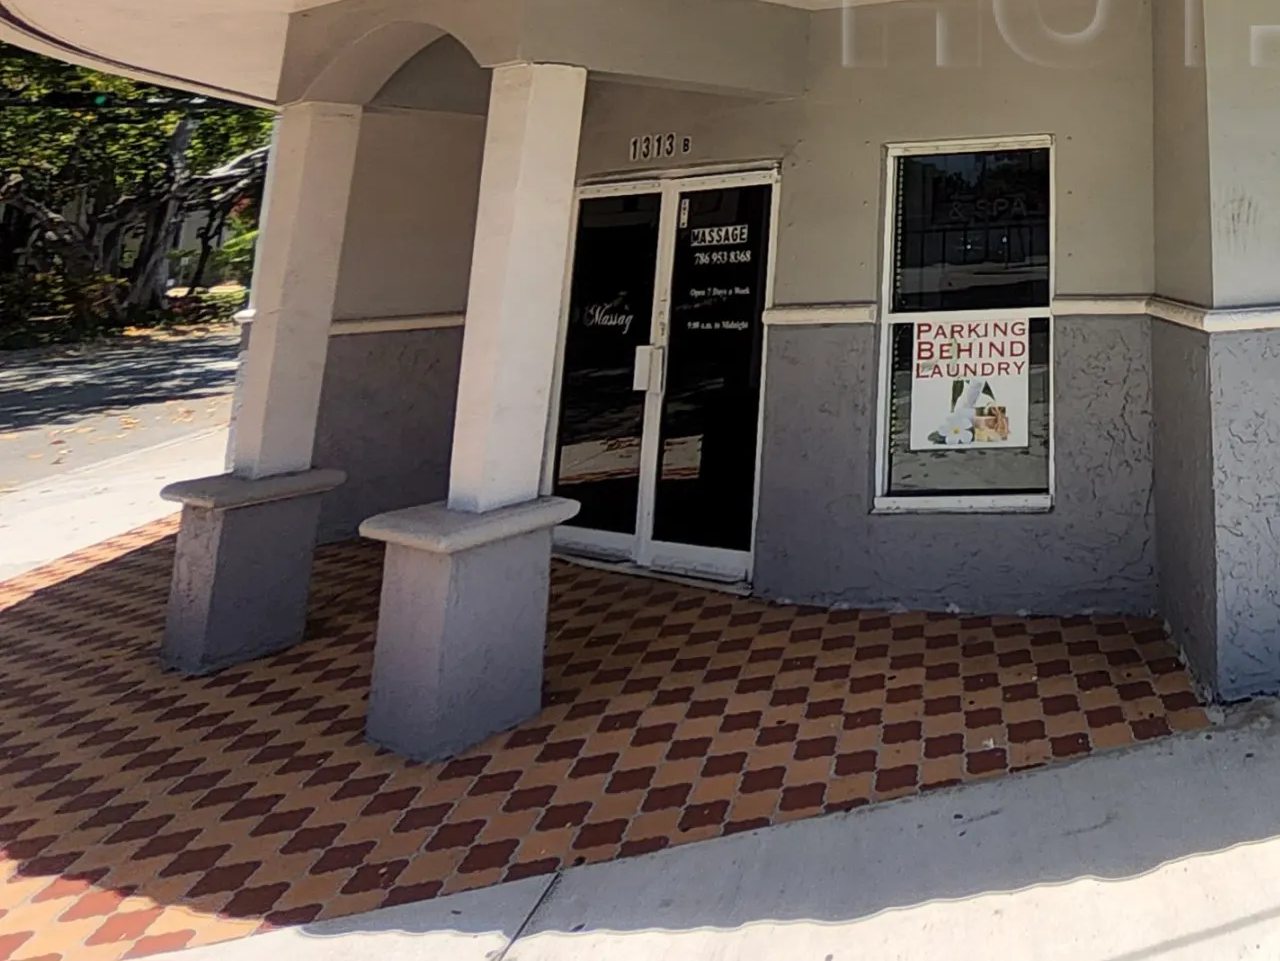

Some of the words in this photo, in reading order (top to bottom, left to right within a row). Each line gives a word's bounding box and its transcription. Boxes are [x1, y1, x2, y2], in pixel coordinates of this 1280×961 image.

[631, 133, 675, 160] 1313
[682, 137, 690, 153] B
[692, 225, 748, 246] MASSAGE
[694, 252, 710, 265] 786
[711, 251, 727, 264] 953
[729, 250, 751, 263] 8368
[917, 321, 1026, 340] PARKING
[917, 340, 1026, 360] BEHIND
[916, 361, 1026, 379] LAUNDRY
